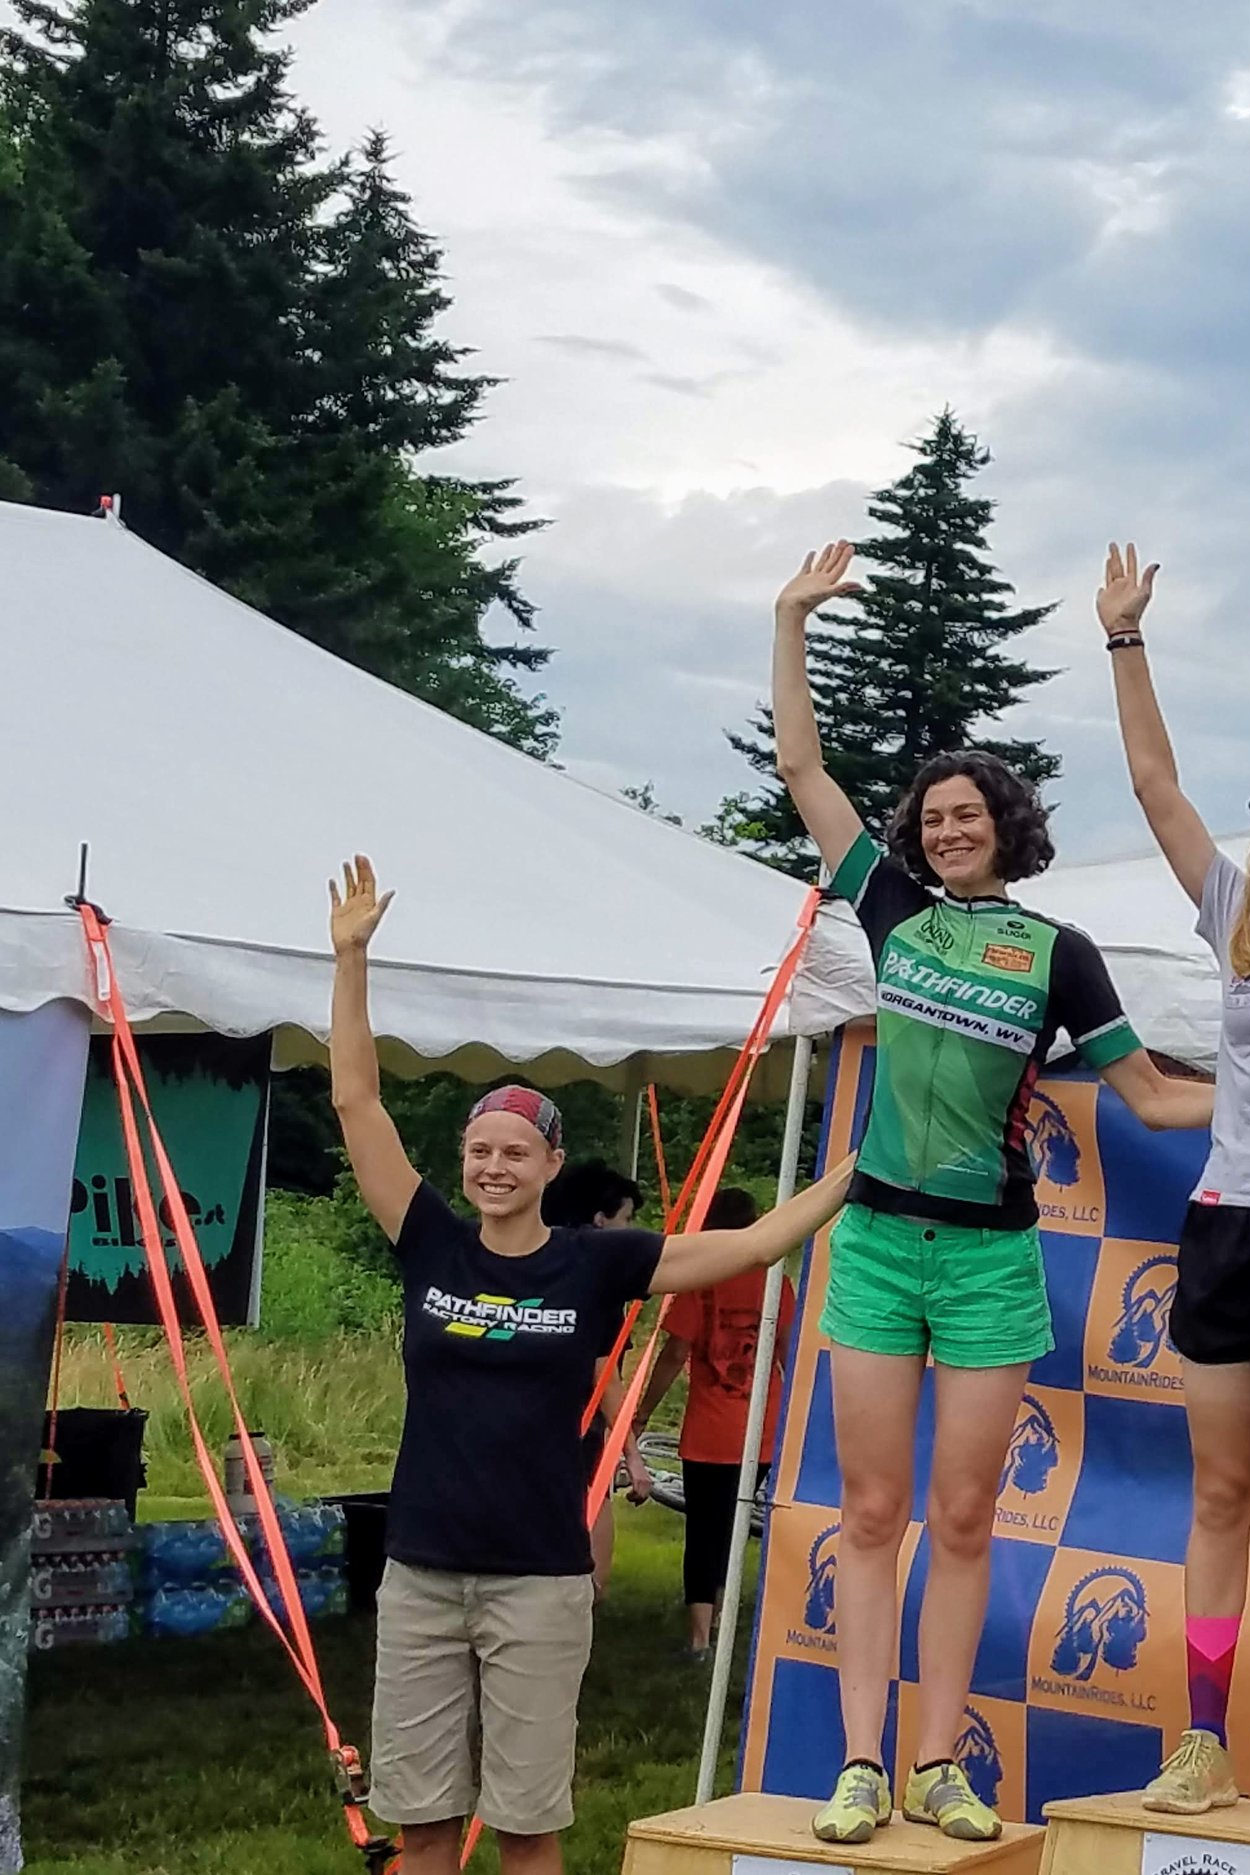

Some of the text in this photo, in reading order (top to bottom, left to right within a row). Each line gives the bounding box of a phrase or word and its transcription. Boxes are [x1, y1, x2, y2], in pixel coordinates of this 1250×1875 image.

[996, 1027, 1025, 1043] WV
[1072, 1205, 1099, 1222] LLC
[426, 1286, 577, 1325] PATHFINDER
[503, 1321, 576, 1334] RACING
[1032, 1512, 1059, 1531] LLC
[1130, 1692, 1157, 1711] LLC
[1154, 1853, 1238, 1875] RAVEL RACE
